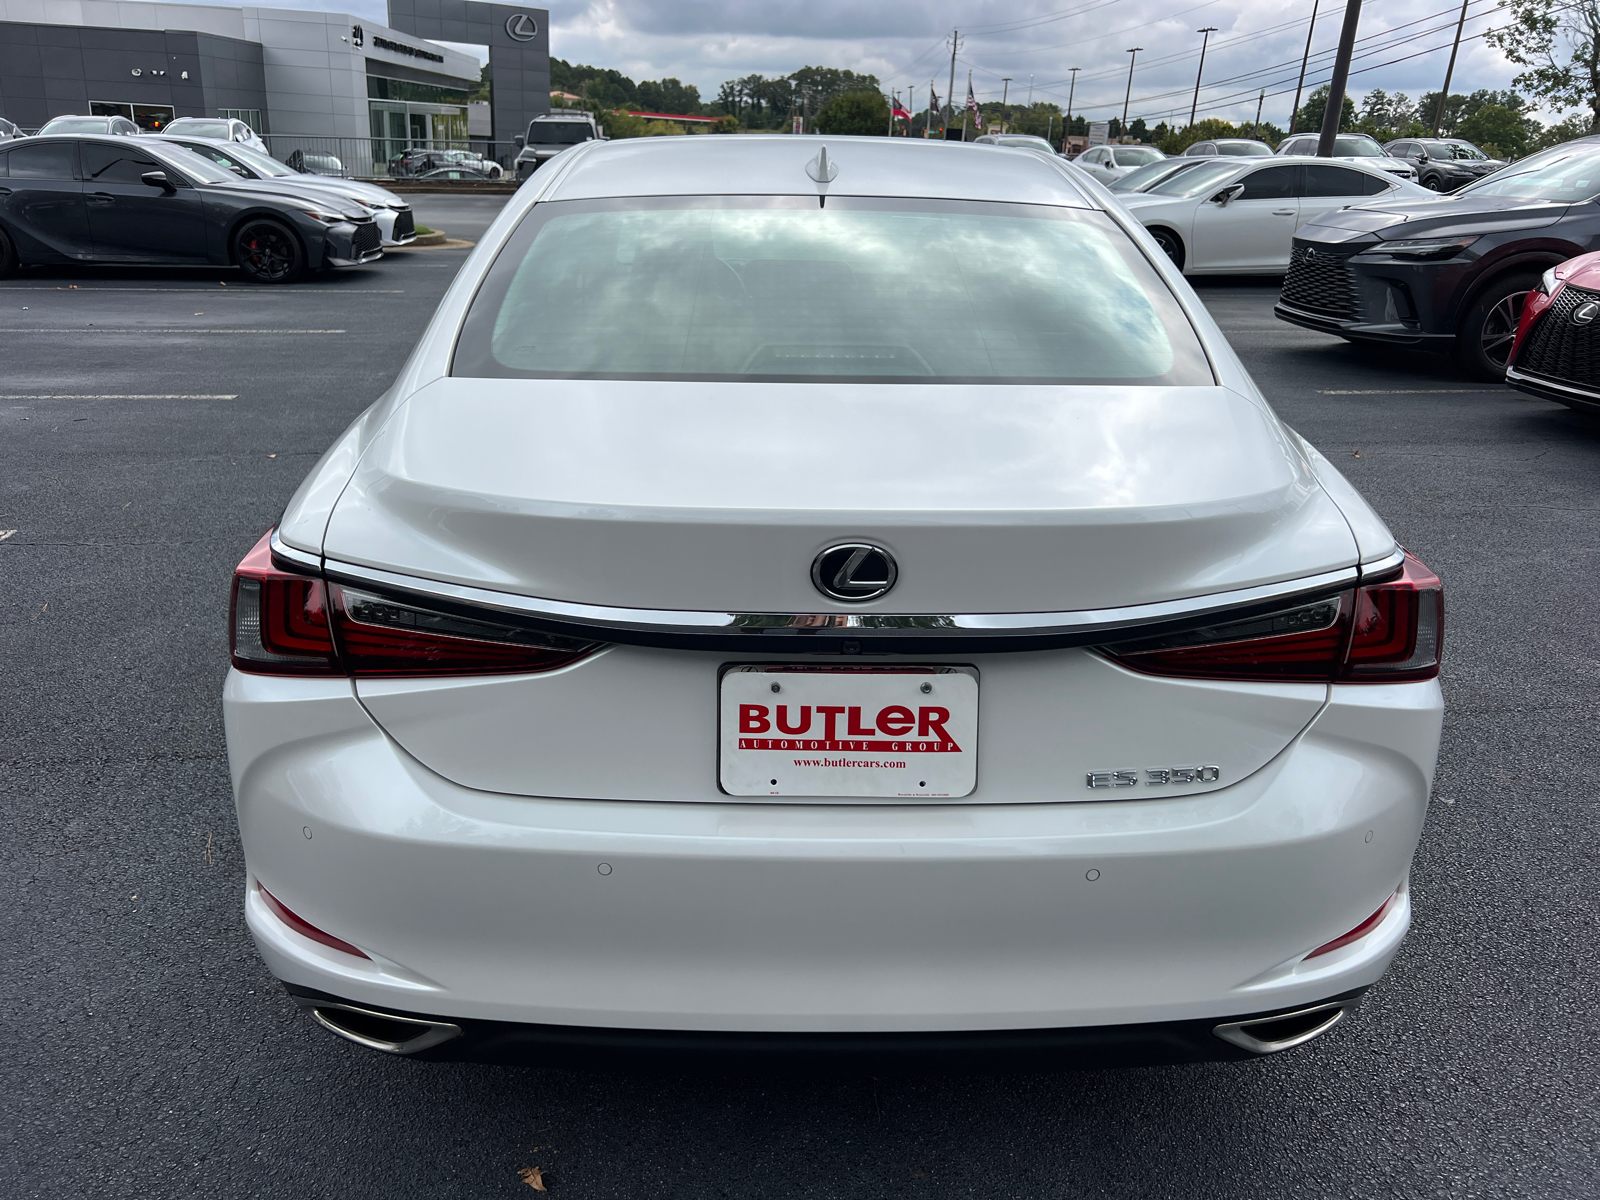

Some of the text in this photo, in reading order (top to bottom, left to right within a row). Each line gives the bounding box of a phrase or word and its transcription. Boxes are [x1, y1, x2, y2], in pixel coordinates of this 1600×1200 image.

[739, 704, 959, 742] BUTLeR
[739, 740, 954, 752] AUTOMOTIVE GROUP
[793, 758, 906, 769] www.butlercars.com
[1086, 764, 1220, 789] ES 350
